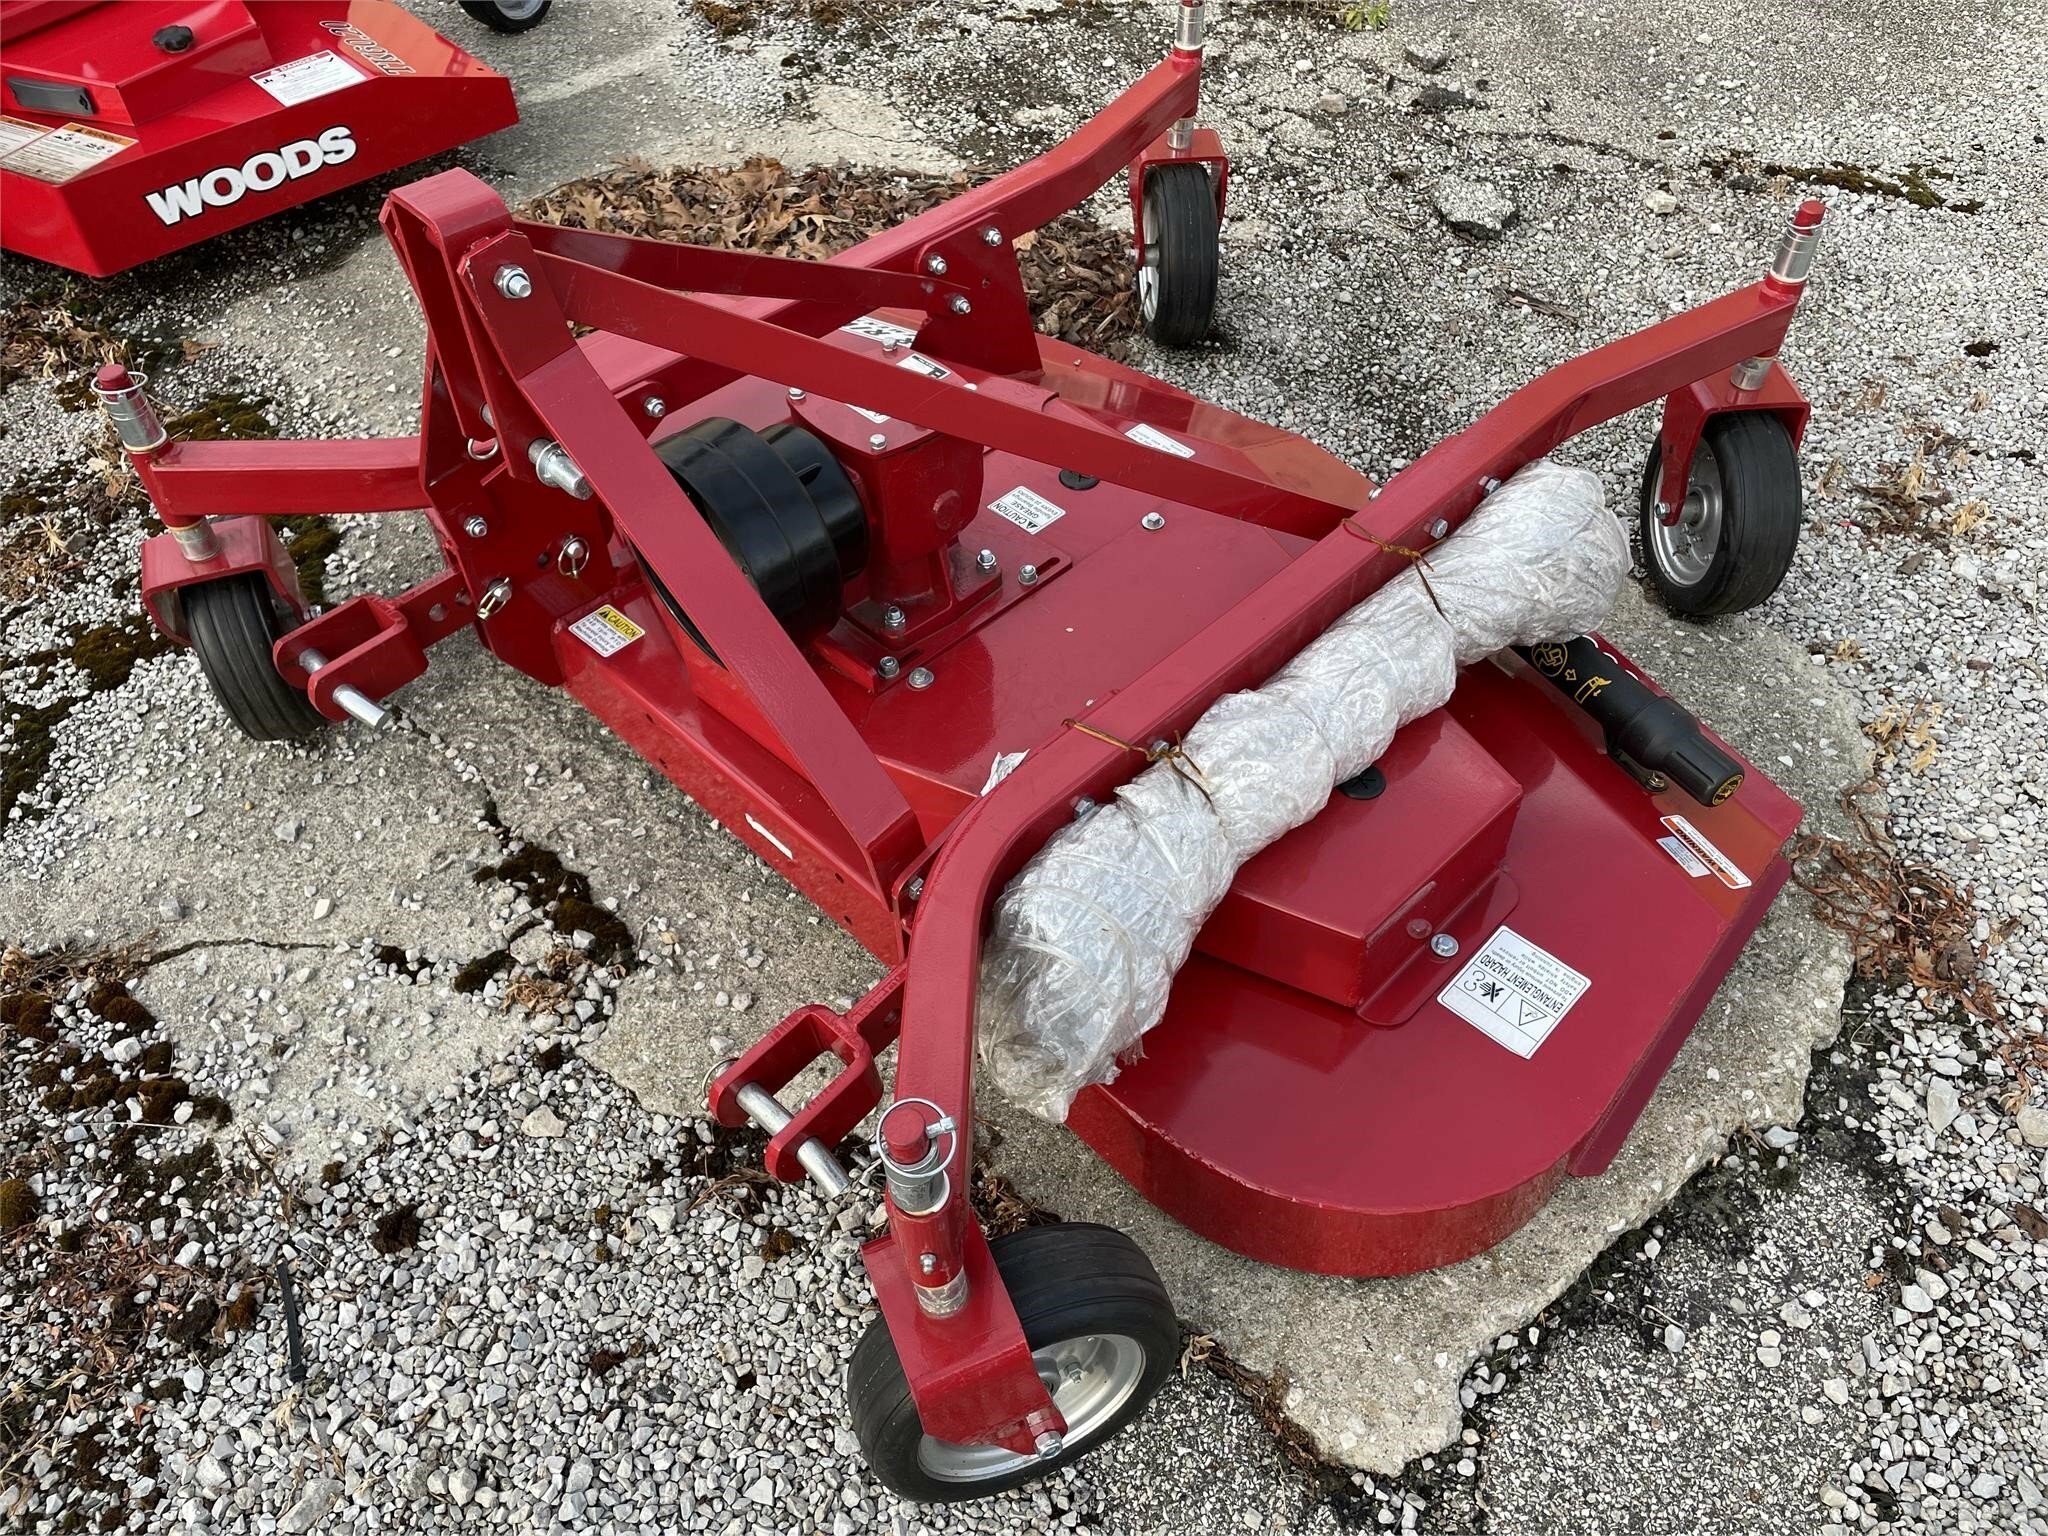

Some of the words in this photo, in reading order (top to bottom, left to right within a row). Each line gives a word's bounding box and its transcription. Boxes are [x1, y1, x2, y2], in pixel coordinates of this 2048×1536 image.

[145, 125, 357, 226] WOODS
[992, 503, 1028, 524] CAUTION
[1009, 501, 1039, 518] GREASE
[607, 615, 638, 637] CAUTION
[1674, 829, 1716, 865] WARNING
[1498, 946, 1519, 961] remove
[1520, 952, 1536, 964] while
[1479, 953, 1510, 977] HAZARD
[1525, 964, 1544, 978] unbolt
[1537, 963, 1558, 979] shields
[1524, 971, 1543, 985] serious
[1545, 977, 1558, 987] NOT
[1559, 977, 1578, 991] safety
[1562, 971, 1582, 986] engine
[1506, 971, 1563, 1013] ENTANGLEMENT
[1542, 982, 1562, 997] prevent
